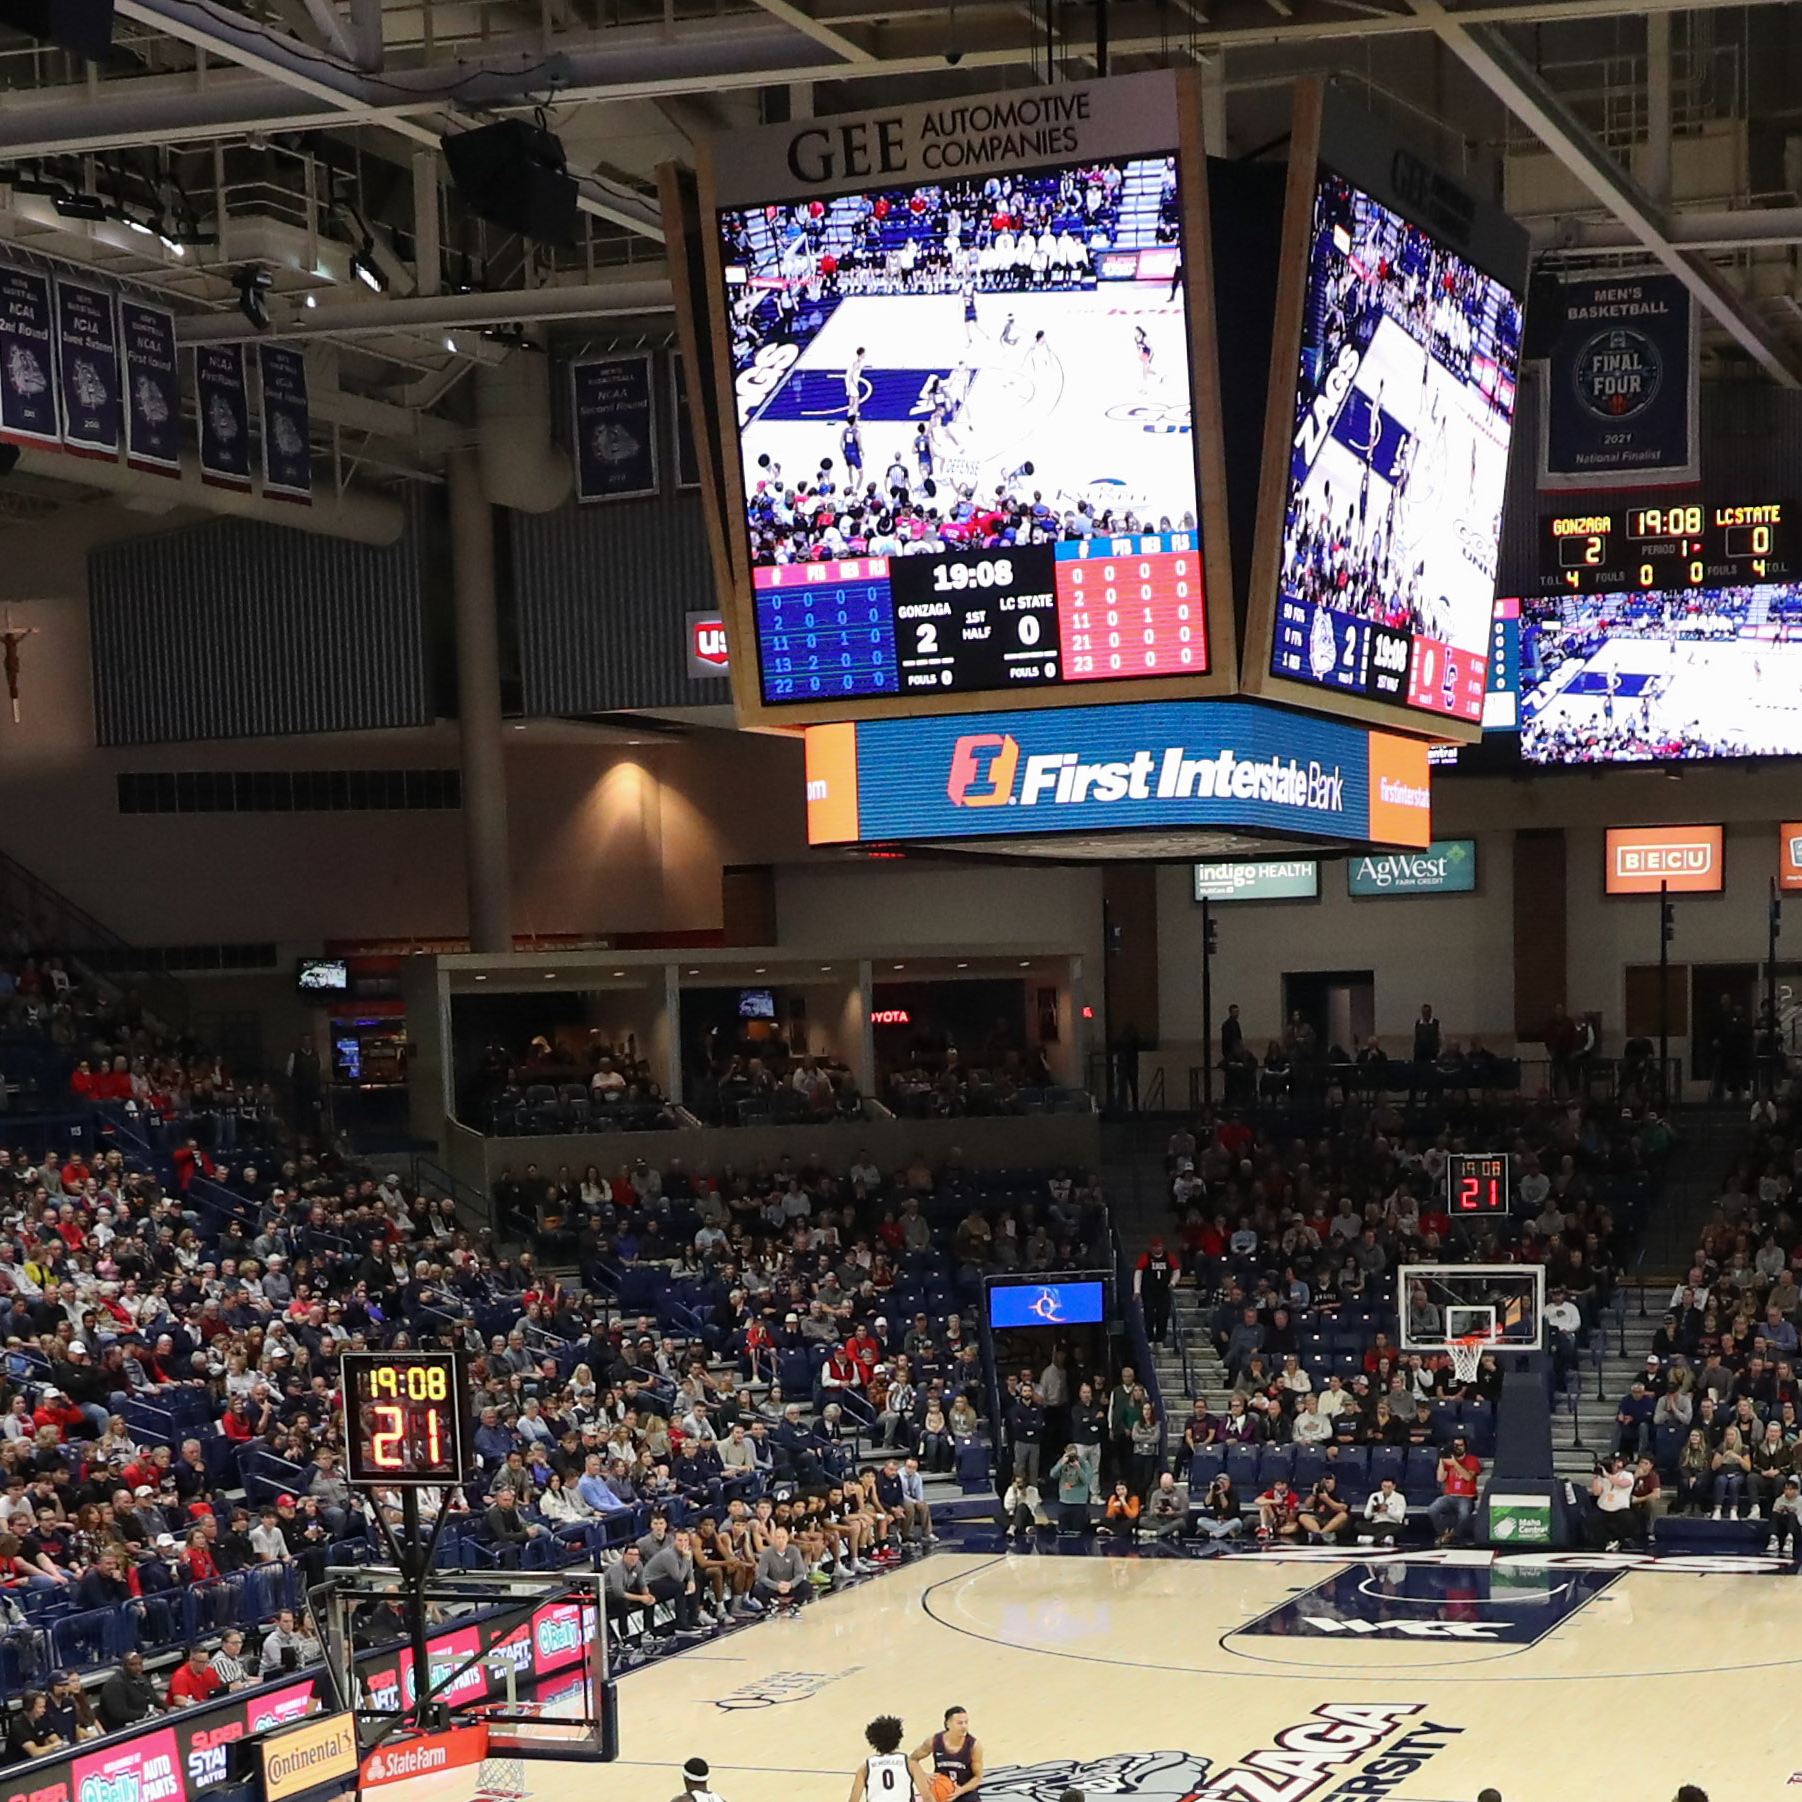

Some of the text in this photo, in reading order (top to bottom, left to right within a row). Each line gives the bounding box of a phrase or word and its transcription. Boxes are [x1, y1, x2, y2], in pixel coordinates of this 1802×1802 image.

[786, 92, 1092, 184] GEE AUTOMOTIVE
[921, 126, 1079, 171] COMPANIES
[1594, 287, 1643, 302] MEN'S
[1567, 301, 1670, 321] BASKETBALL
[1592, 353, 1643, 373] FINAL
[1593, 374, 1642, 396] FOUR
[1603, 433, 1633, 445] 2021
[1575, 449, 1662, 465] National Finalist
[1552, 516, 1612, 537] GONZAGA
[1636, 506, 1702, 537] 19:08
[1585, 536, 1602, 564] 2
[1641, 544, 1676, 556] PERIOD
[1752, 526, 1770, 554] 0
[933, 558, 1015, 592] 19:08
[1566, 559, 1767, 589] 4 FOULS 0 0 FOULS 4
[897, 602, 952, 620] GONZAGA
[999, 593, 1054, 611] LC STATE
[965, 610, 987, 625] 1ST
[1017, 614, 1041, 646] 0
[915, 623, 939, 654] 2
[962, 625, 992, 641] HALF
[1341, 625, 1357, 667] 2
[1373, 633, 1409, 673] 19:08
[1423, 649, 1435, 687] 0
[907, 670, 953, 687] FOULS 0
[1009, 662, 1057, 679] FOULS 0
[1018, 747, 1345, 812] First Interstate Bank
[1198, 863, 1313, 889] indigo HEALTH
[1355, 854, 1449, 888] AgWest
[1395, 877, 1444, 887] FARM CREDIT
[1462, 1178, 1500, 1209] 21
[370, 1366, 447, 1401] 19:08
[373, 1406, 440, 1466] 21
[1215, 1545, 1797, 1573] ZAGS
[538, 1616, 579, 1657] O'Reilly
[1302, 1616, 1516, 1638] WCC
[191, 1721, 245, 1752] SUPER
[143, 1754, 172, 1783] AUTO
[268, 1732, 342, 1786] Continental
[882, 1768, 896, 1791] 0
